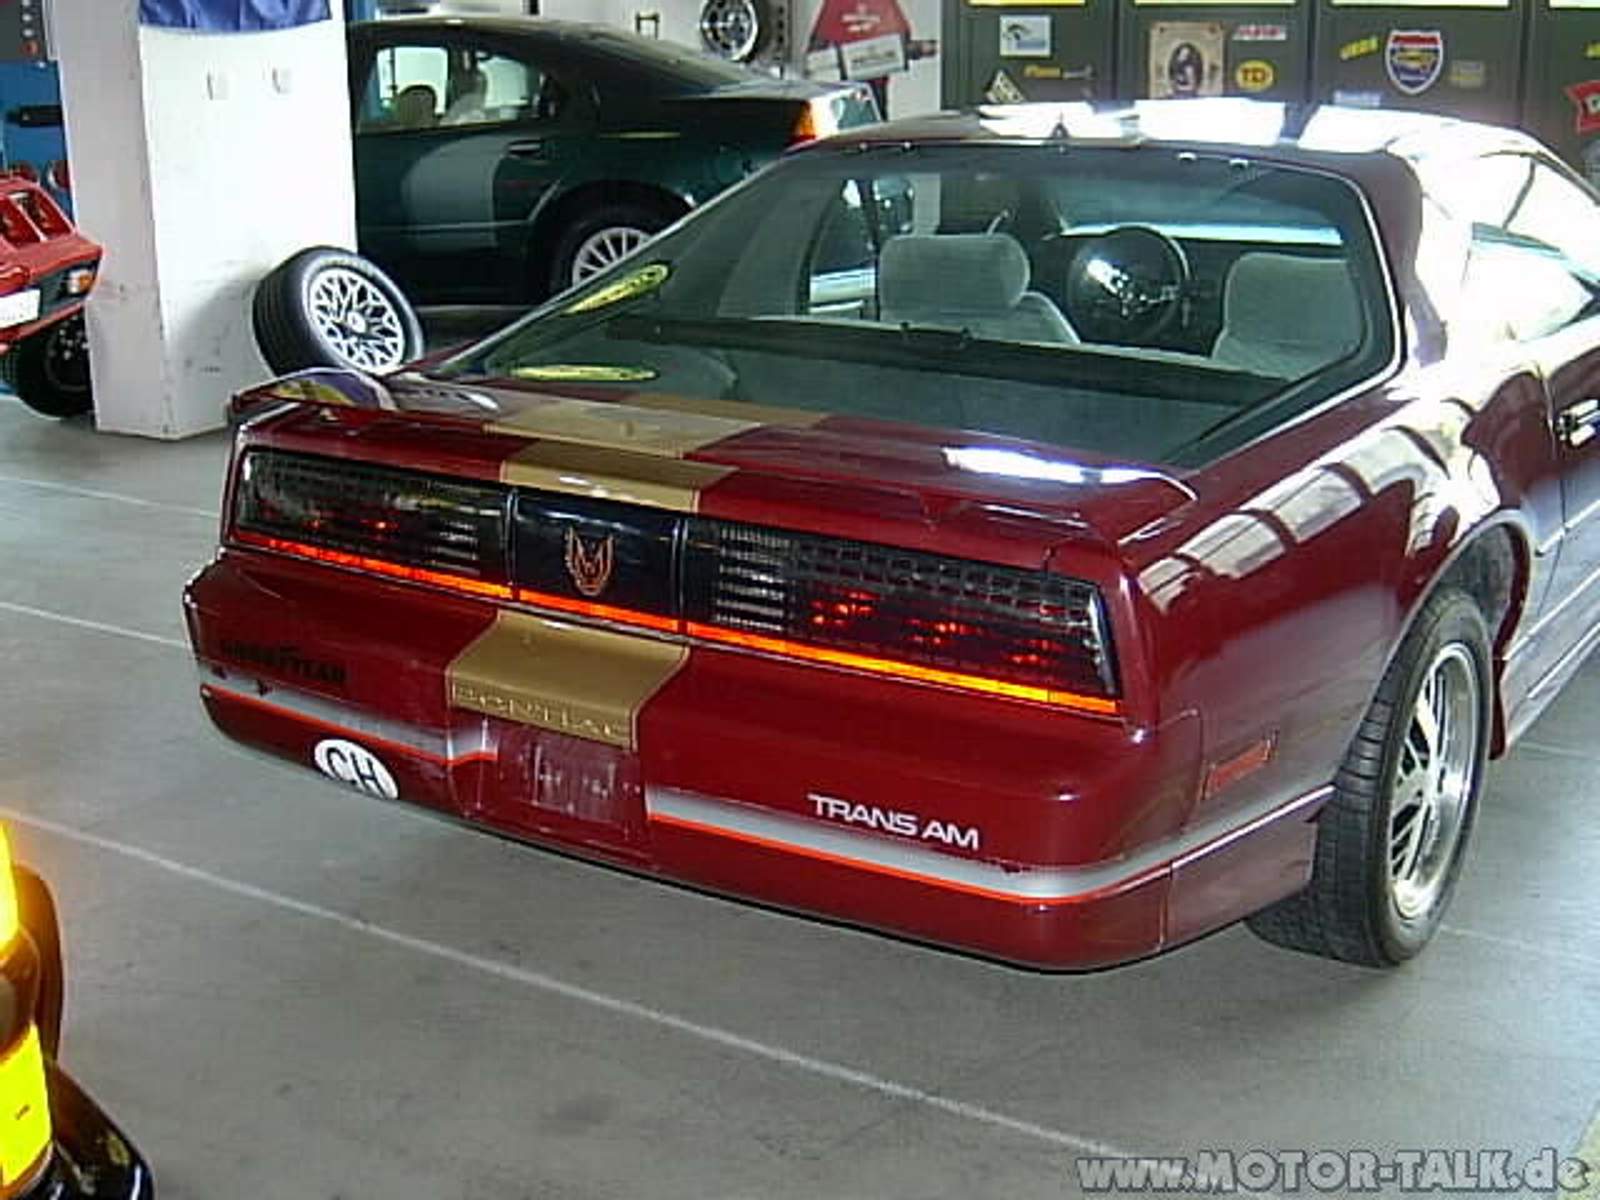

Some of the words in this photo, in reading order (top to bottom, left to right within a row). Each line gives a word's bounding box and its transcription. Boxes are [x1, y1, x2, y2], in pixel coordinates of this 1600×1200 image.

[452, 681, 629, 740] PONTIAC
[325, 746, 387, 799] CH
[807, 793, 918, 836] TRANS
[922, 821, 979, 851] AM
